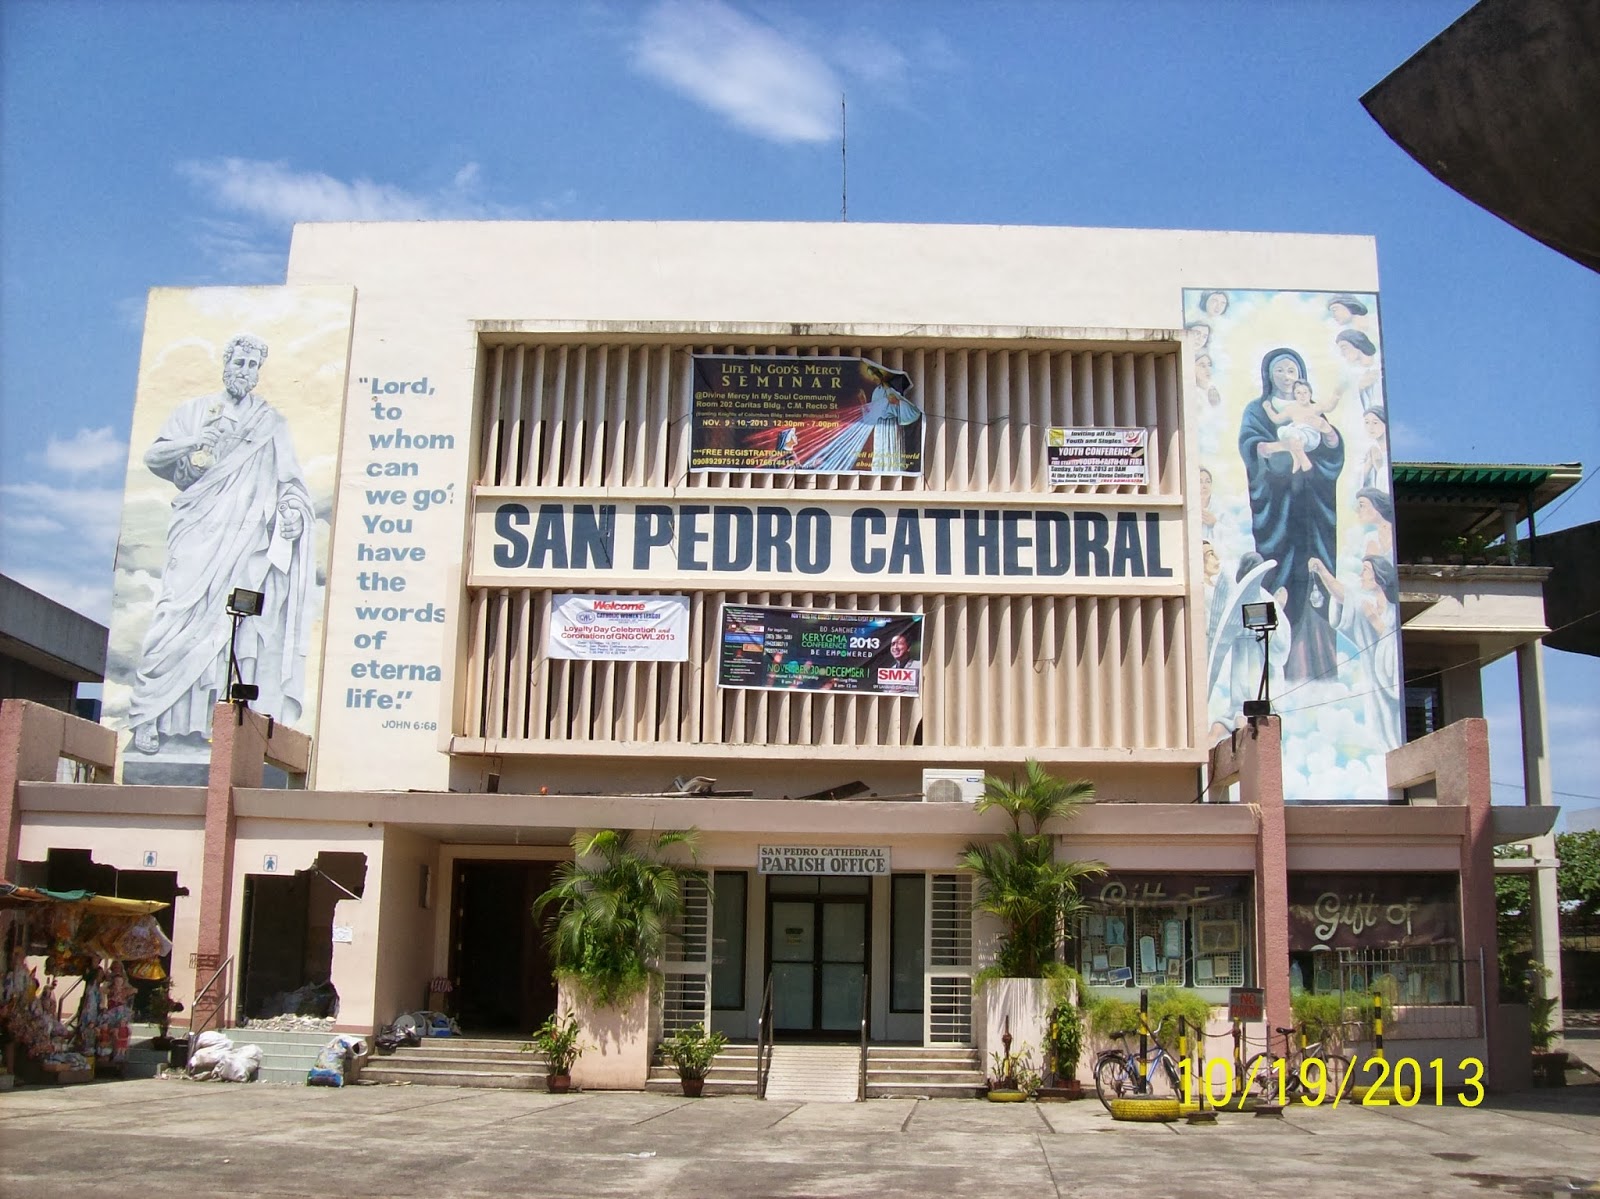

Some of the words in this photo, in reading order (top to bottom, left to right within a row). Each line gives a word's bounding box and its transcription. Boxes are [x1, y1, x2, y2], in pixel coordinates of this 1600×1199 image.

[695, 391, 725, 400] @Divine
[727, 392, 750, 401] Mercy
[752, 392, 759, 400] In
[761, 392, 772, 401] My
[774, 393, 791, 401] Soul
[793, 393, 836, 402] Community
[370, 402, 402, 420] to
[735, 401, 761, 409] Caritas
[787, 402, 804, 410] C.M.
[805, 402, 828, 410] Recto
[829, 402, 838, 410] St
[702, 419, 721, 427] NOV.
[724, 419, 730, 427] 9
[369, 428, 455, 449] whom
[1058, 447, 1084, 456] YOUTH
[1085, 447, 1133, 456] CONFERENCE
[366, 462, 418, 477] can
[365, 489, 407, 505] we
[362, 514, 413, 534] You
[493, 503, 616, 570] SAN
[633, 504, 832, 575] PEDRO
[850, 507, 1174, 578] CATHEDRAL
[357, 543, 426, 562] have
[356, 571, 406, 593] the
[355, 602, 446, 623] words
[593, 601, 646, 611] Welcome
[561, 632, 605, 640] Coronation
[606, 632, 615, 640] of
[656, 633, 675, 641] 2013
[564, 625, 593, 634] Loyalty
[593, 625, 609, 635] Day
[610, 625, 656, 634] Celebration
[353, 630, 387, 650] of
[801, 641, 847, 649] CONFERENCE
[802, 632, 847, 643] KERYGMA
[849, 637, 880, 649] 2013
[826, 649, 873, 658] EMPOWERED
[825, 666, 864, 678] DECEMBER
[878, 669, 913, 681] SMX
[381, 720, 411, 730] JOHN
[413, 720, 437, 731] 6:68
[761, 847, 781, 856] SAN
[784, 848, 818, 856] PEDRO
[821, 848, 884, 857] CATHEDRAL
[761, 857, 825, 872] PARISH
[830, 857, 885, 873] OFFICE
[1315, 892, 1379, 941] Gift
